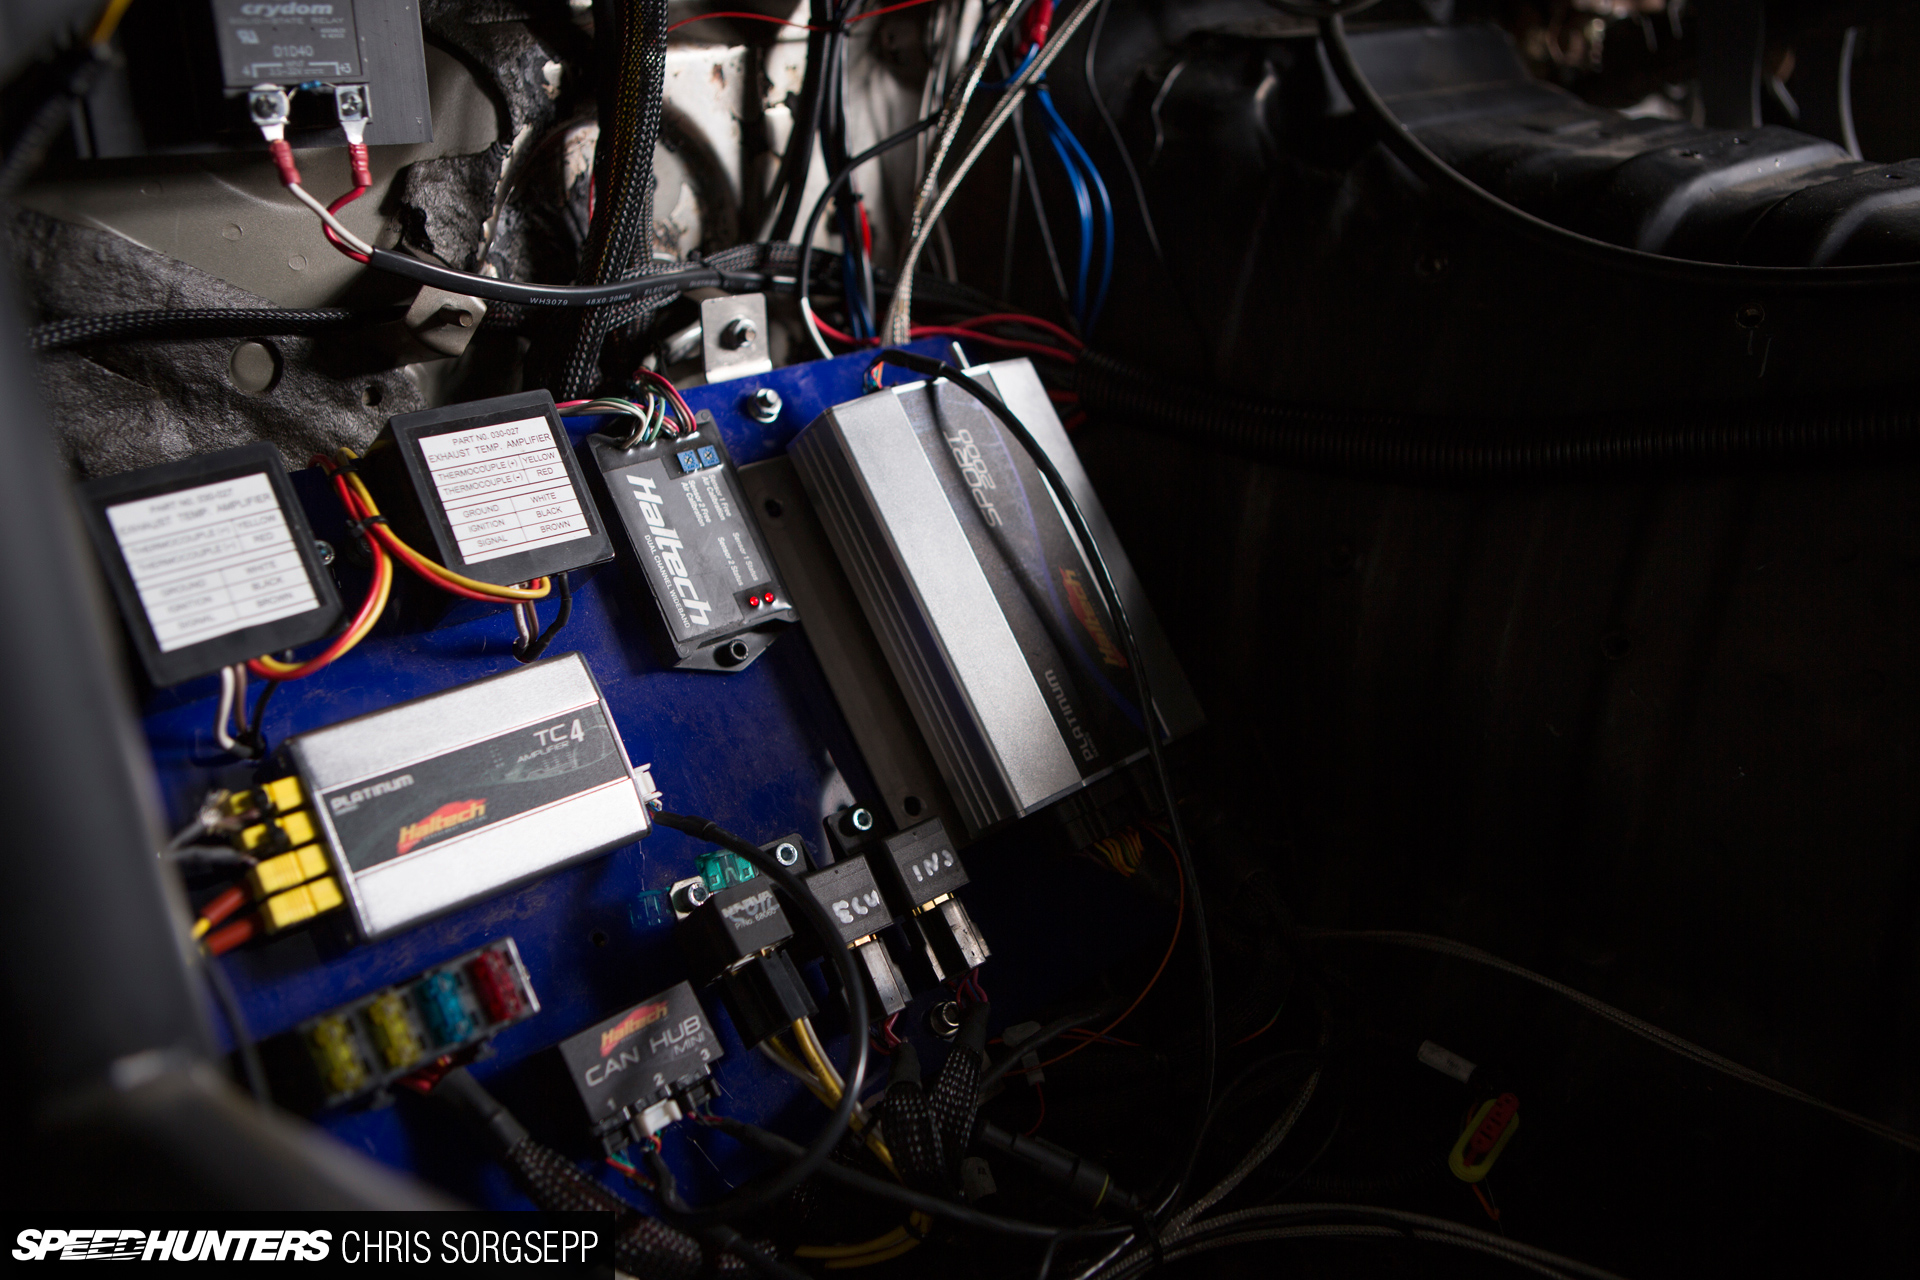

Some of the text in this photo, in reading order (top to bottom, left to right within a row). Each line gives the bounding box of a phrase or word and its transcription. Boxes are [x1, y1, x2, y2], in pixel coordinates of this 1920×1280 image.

[241, 2, 333, 17] crydom
[529, 297, 568, 305] WH3079
[428, 433, 552, 464] EXHAUST TEMP. AMPLIFIER
[452, 435, 474, 446] PART
[491, 427, 520, 440] 030-027
[438, 461, 507, 482] THERMOCOUPLE
[522, 452, 556, 465] YELLOW
[958, 429, 996, 489] 2000
[443, 475, 512, 496] THERMOCOUPLE
[536, 467, 554, 477] RED
[943, 431, 1003, 527] SPORT
[216, 493, 271, 513] AMPLIFIER
[462, 492, 557, 519] GROUND WHITE
[680, 481, 705, 527] Air Calibration
[688, 479, 703, 503] Sensor
[700, 508, 712, 523] Free
[701, 476, 726, 521] Air Calibration
[708, 474, 722, 497] Sensor
[721, 502, 732, 517] Free
[235, 514, 276, 530] YELLOW
[468, 506, 563, 533] IGNITION BLACK
[476, 520, 571, 548] SIGNAL BROWN
[253, 532, 274, 543] RED
[626, 474, 712, 626] Haltech
[717, 536, 732, 559] Sensor
[731, 565, 744, 586] Status
[732, 532, 747, 555] Sensor
[746, 560, 759, 581] Status
[251, 576, 283, 591] BLACK
[644, 534, 691, 629] DUAL CHANNEL WIDEBAND
[257, 592, 294, 608] BROWN
[1044, 669, 1094, 762] PLATINUM
[517, 740, 569, 763] AMPLIFIER
[330, 773, 414, 812] PLATINUM
[399, 803, 486, 843] Haltech
[832, 889, 880, 924] ECU
[601, 1005, 668, 1048] Haltech
[585, 1046, 640, 1087] CAN
[649, 1015, 702, 1053] HUB
[674, 1031, 705, 1055] MINI
[700, 1048, 711, 1061] 3
[653, 1072, 666, 1087] 2
[607, 1097, 616, 1110] 1
